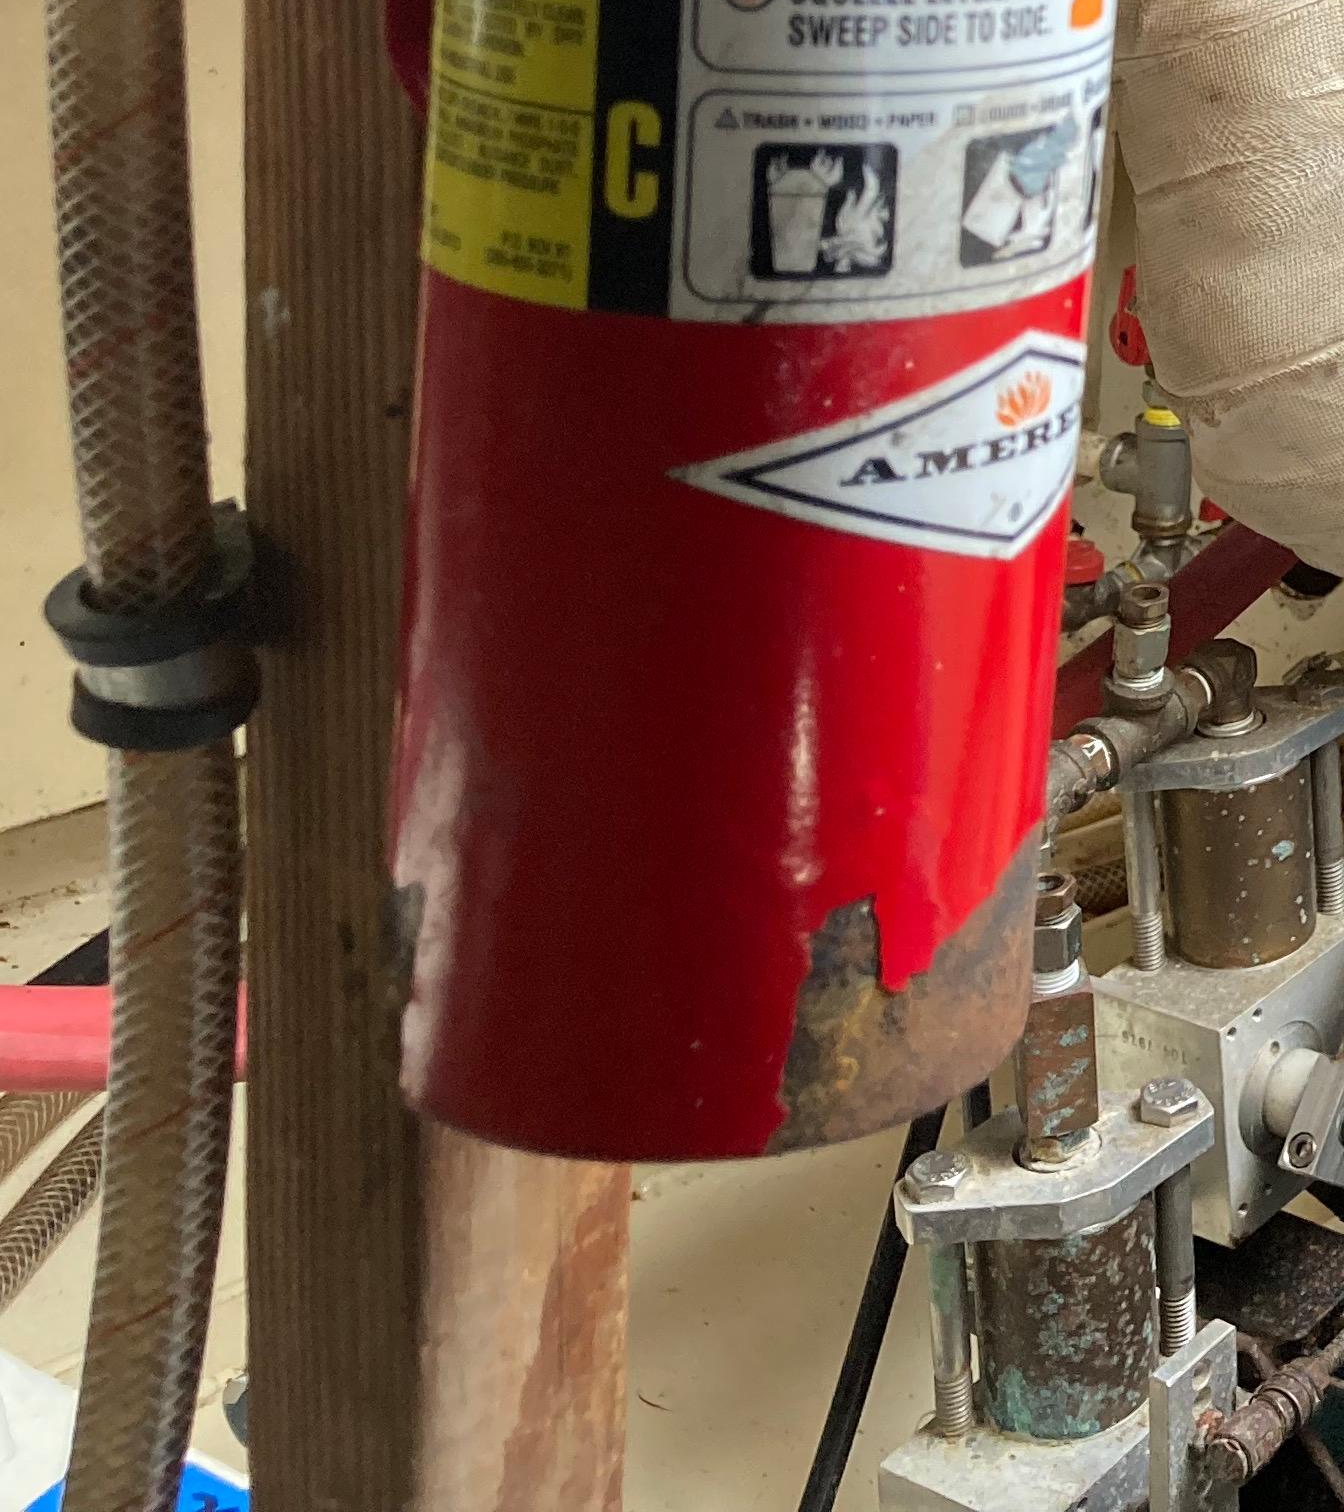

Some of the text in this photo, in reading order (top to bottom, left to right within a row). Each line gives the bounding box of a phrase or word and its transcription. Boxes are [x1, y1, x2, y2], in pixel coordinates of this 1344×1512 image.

[788, 4, 1054, 48] SWEEP SIDE TO SIDE.
[605, 97, 662, 220] C
